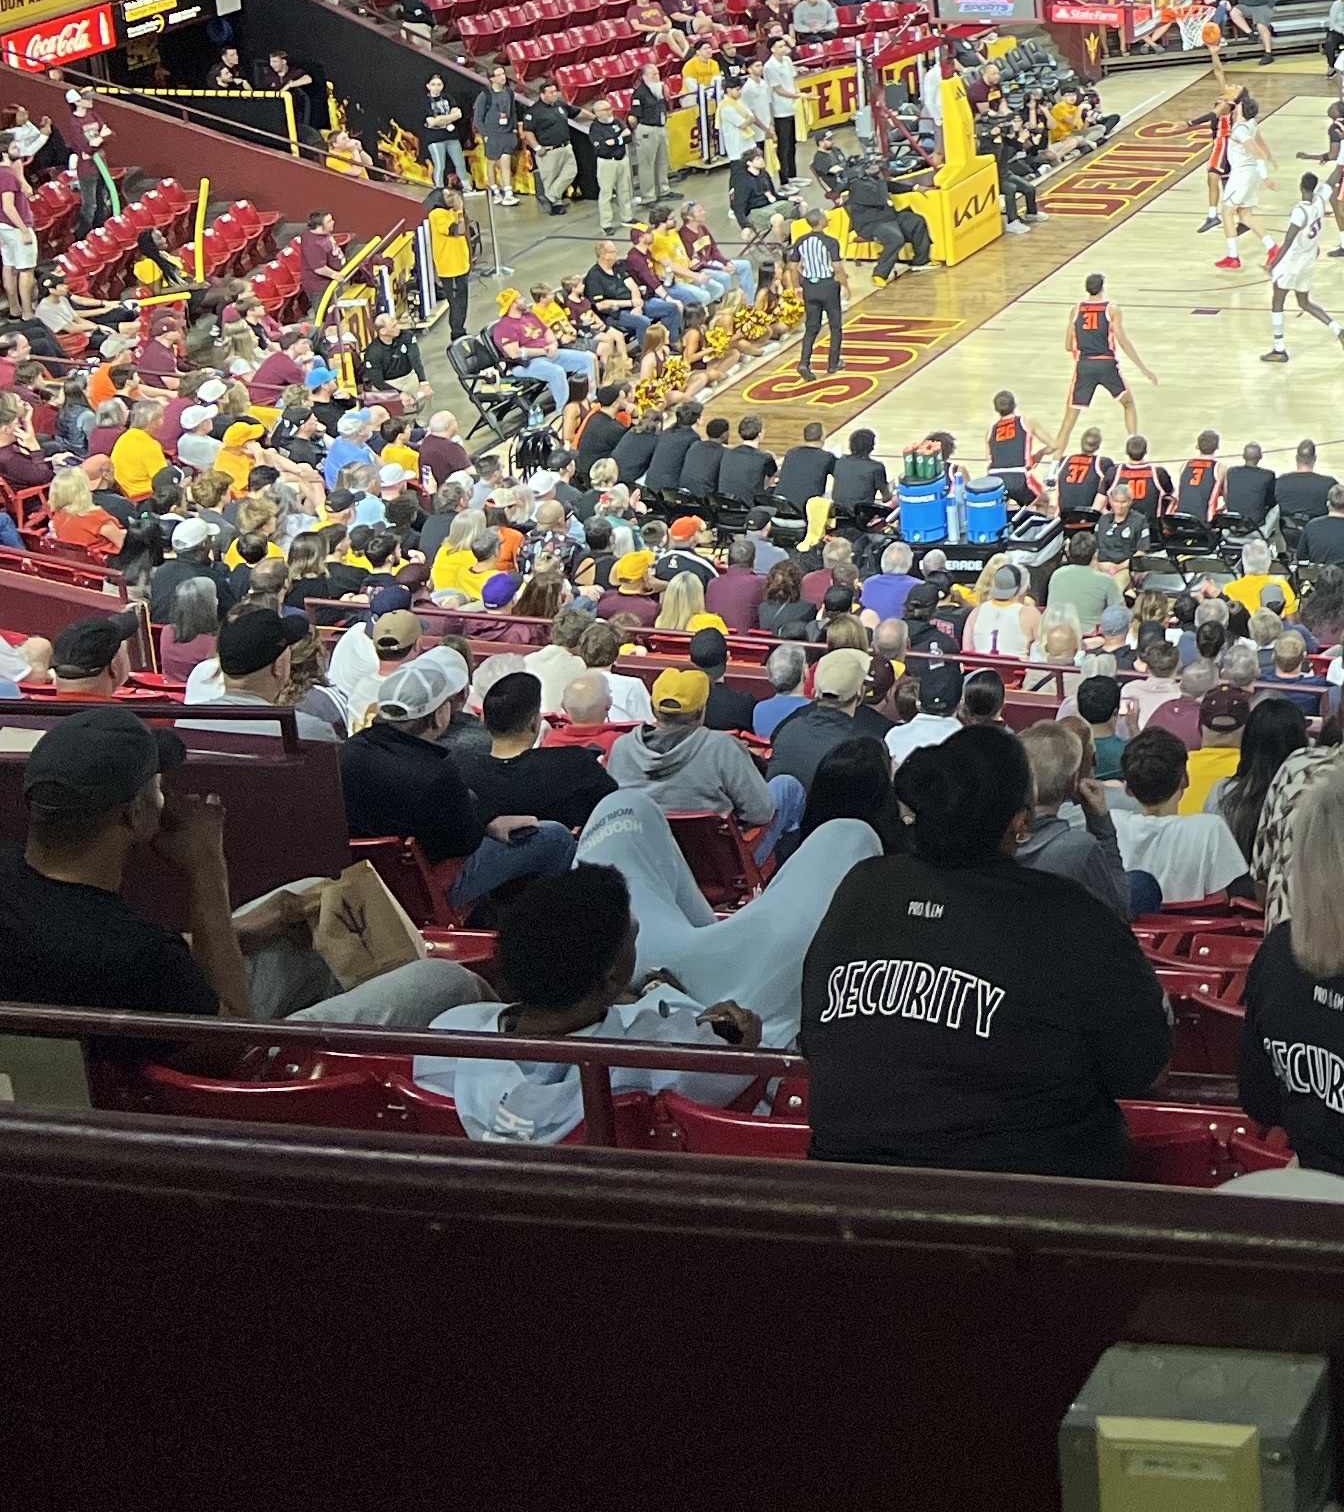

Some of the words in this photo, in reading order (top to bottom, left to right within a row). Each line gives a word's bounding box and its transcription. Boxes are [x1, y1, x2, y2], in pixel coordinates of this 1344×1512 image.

[962, 4, 1010, 12] SPORTS
[1036, 119, 1216, 220] DEVILS
[1082, 312, 1098, 330] 31
[741, 312, 966, 407] SUN
[995, 425, 1016, 442] 26
[1067, 465, 1088, 484] 37
[1189, 469, 1203, 486] 3
[991, 629, 999, 655] 1
[820, 959, 1006, 1038] SECURITY
